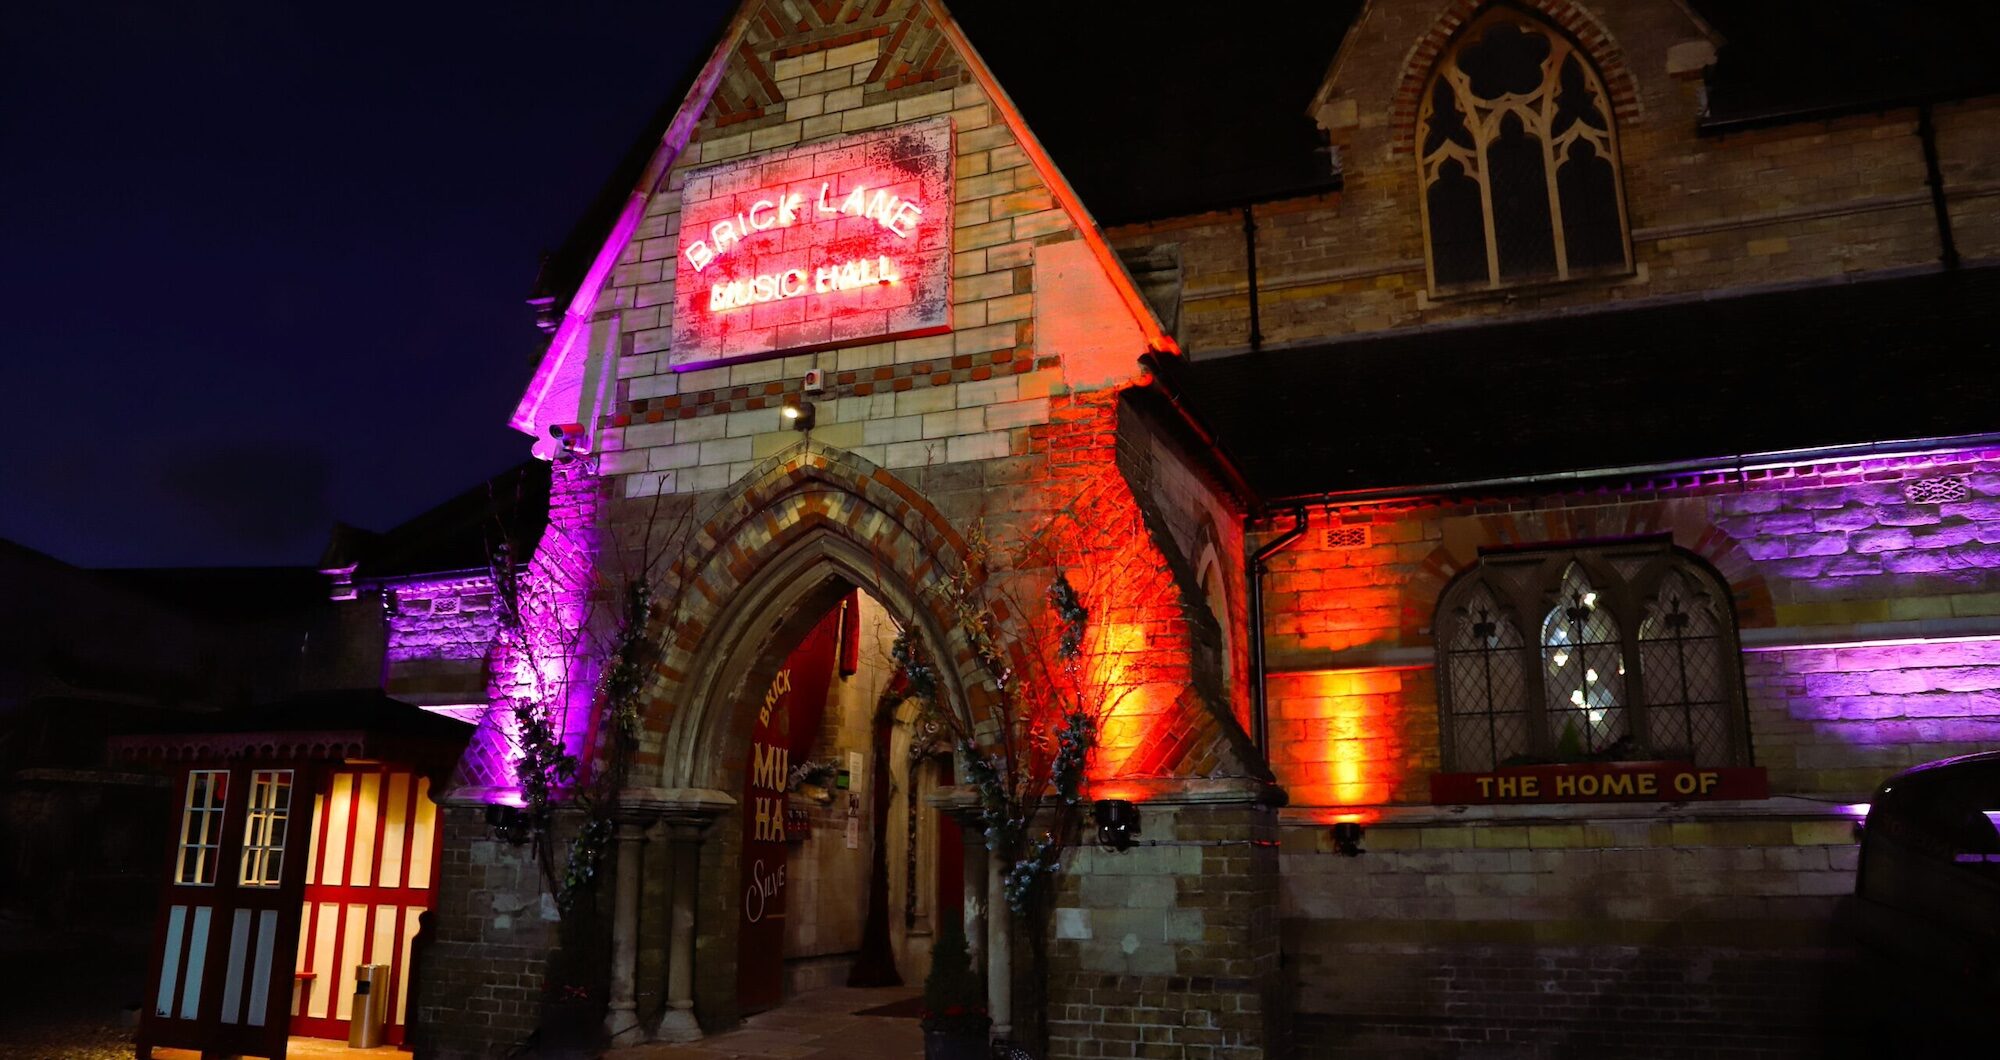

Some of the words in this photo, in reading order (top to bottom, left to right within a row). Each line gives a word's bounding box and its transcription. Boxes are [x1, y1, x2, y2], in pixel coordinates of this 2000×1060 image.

[685, 193, 801, 272] BRICK
[817, 182, 922, 239] LANE
[710, 269, 806, 311] MUSIC
[815, 255, 897, 294] HALL
[760, 669, 792, 728] BRICK
[753, 742, 788, 792] MU
[1476, 776, 1539, 798] THE
[1556, 773, 1657, 796] HOME
[1674, 772, 1718, 794] OF
[755, 797, 786, 841] HA
